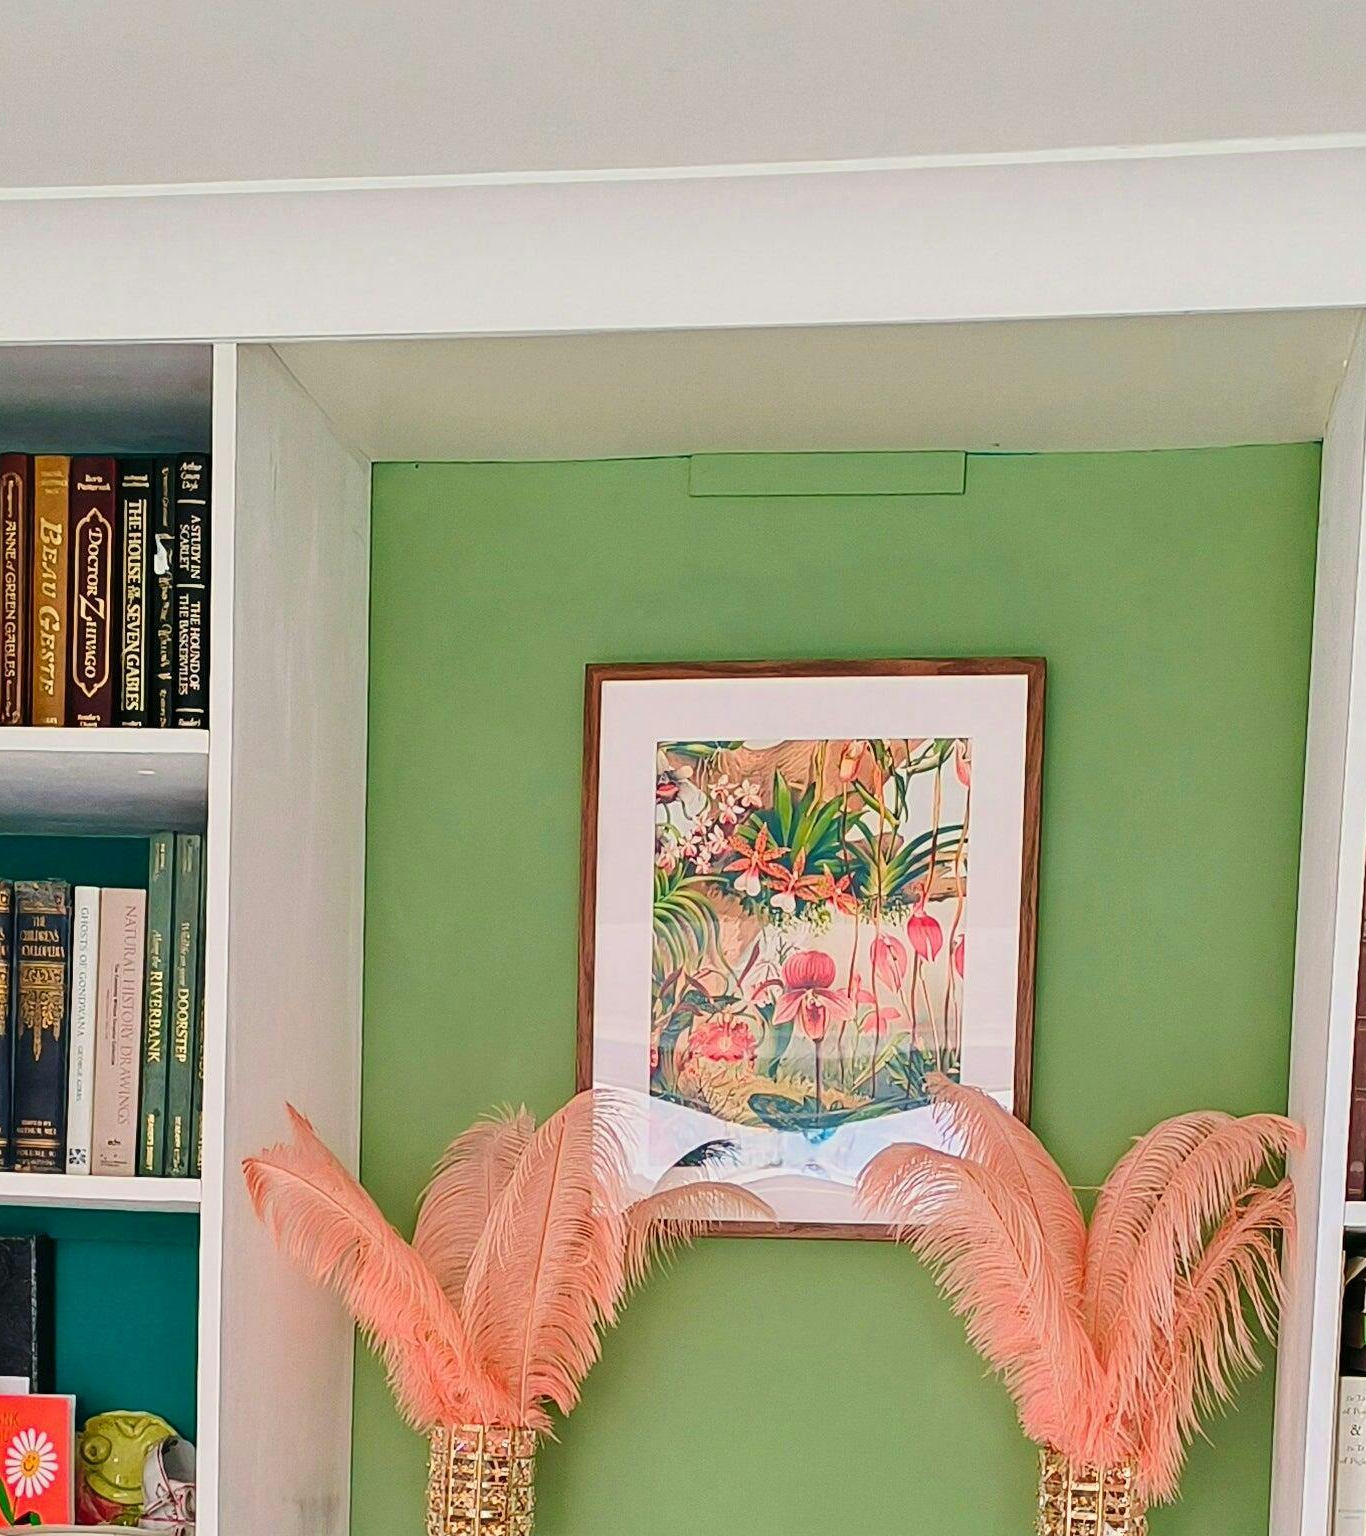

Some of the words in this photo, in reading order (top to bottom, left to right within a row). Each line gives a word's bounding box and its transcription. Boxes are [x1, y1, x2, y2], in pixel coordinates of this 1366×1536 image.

[127, 500, 142, 533] THE
[39, 517, 63, 598] BEAU
[85, 527, 103, 596] DOCTOR
[126, 536, 142, 584] HOUSE
[38, 605, 60, 697] GESTE
[79, 595, 106, 679] ZHIVAGO
[124, 604, 142, 653] SEVEN
[126, 654, 141, 711] GABLES
[123, 904, 138, 976] NATURAL
[120, 979, 135, 1040] HISTORY
[147, 970, 163, 1063] RIVERBANK
[174, 987, 190, 1063] DOORSTEP
[117, 1045, 133, 1125] DRAWINGS
